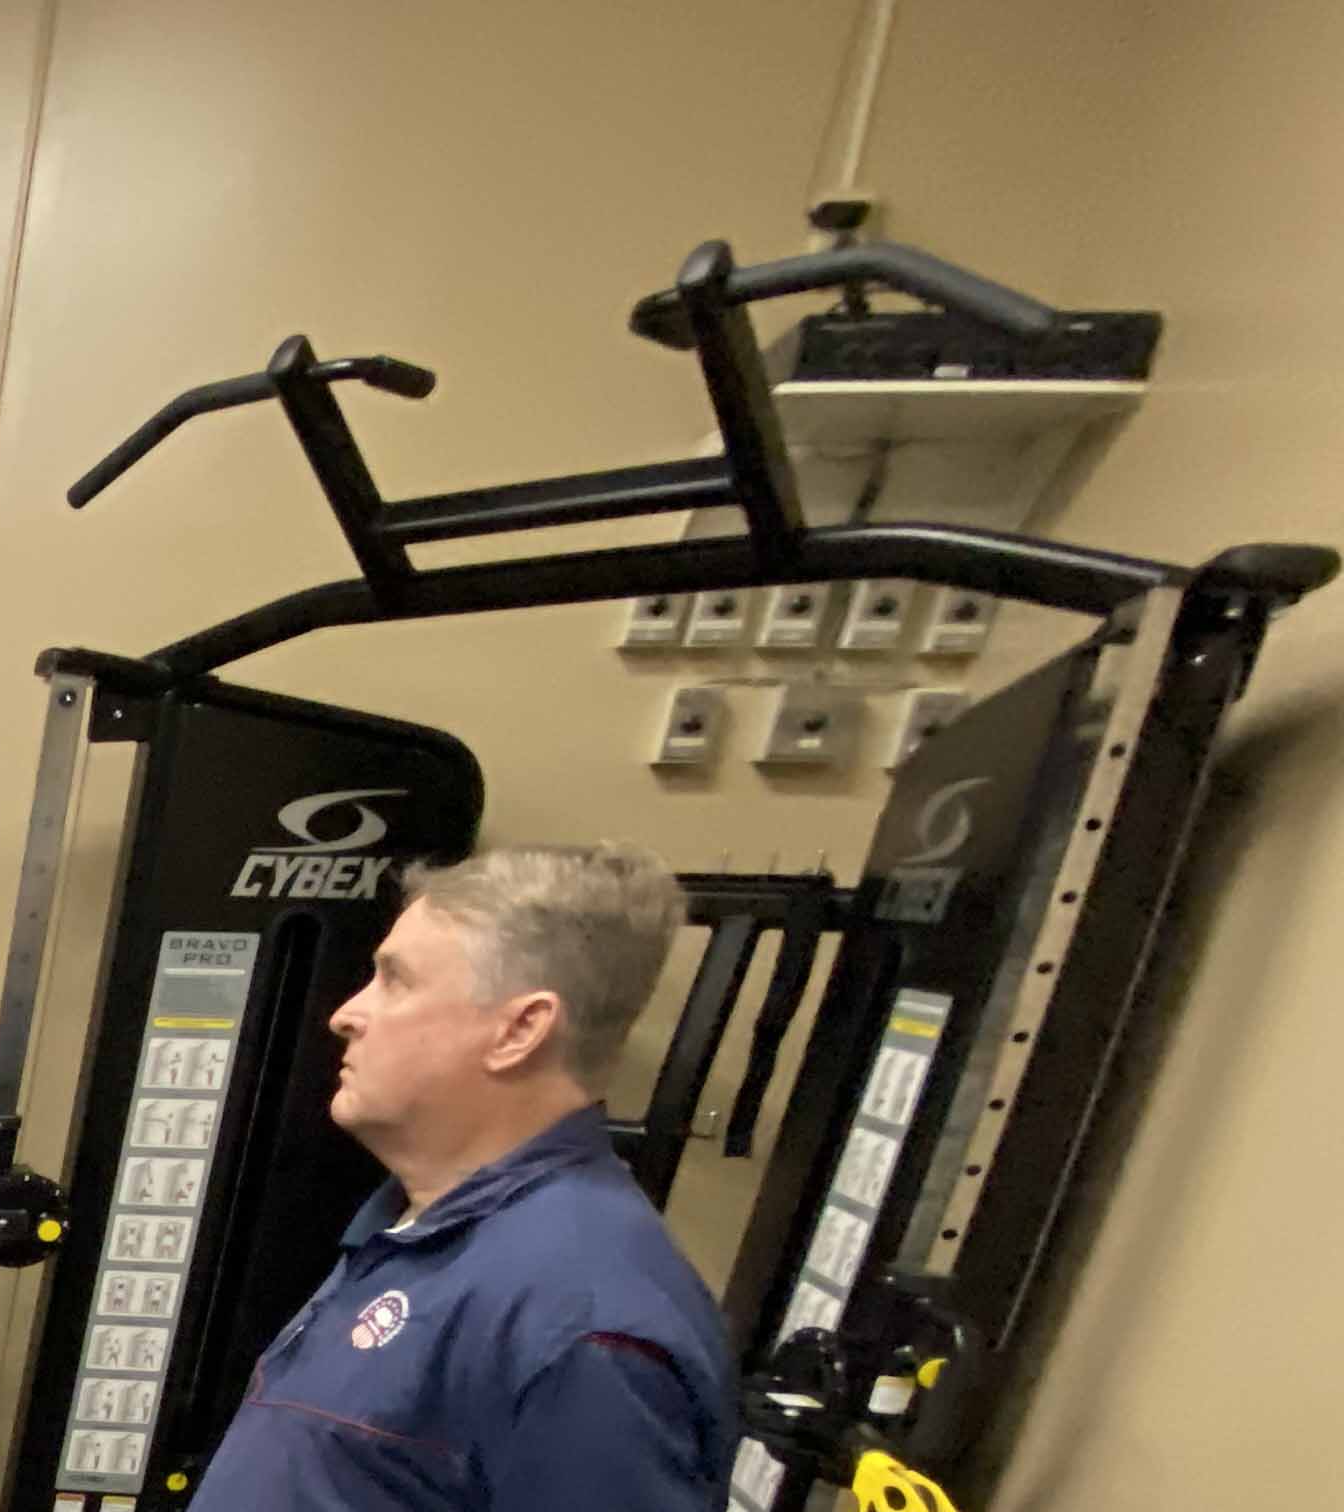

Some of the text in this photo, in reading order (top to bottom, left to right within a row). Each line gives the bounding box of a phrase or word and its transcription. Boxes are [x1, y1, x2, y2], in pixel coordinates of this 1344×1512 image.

[229, 853, 393, 900] CYBEX
[169, 937, 249, 952] BRAVO
[182, 951, 233, 966] PRO
